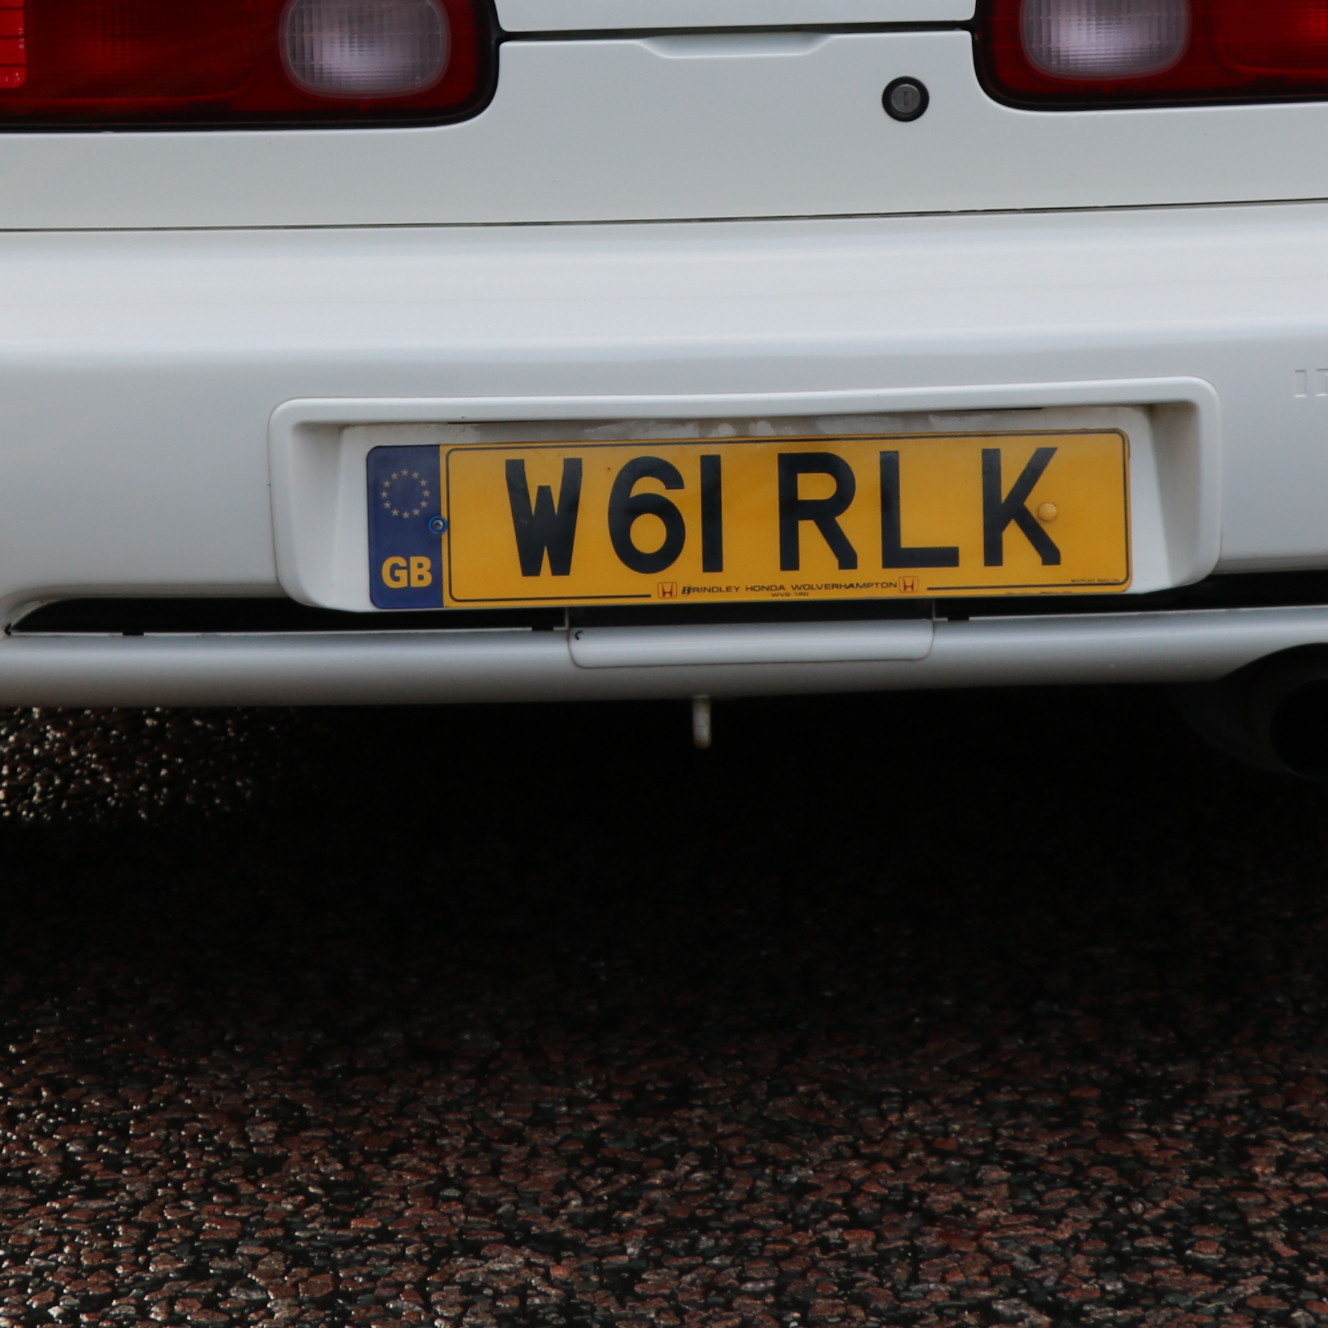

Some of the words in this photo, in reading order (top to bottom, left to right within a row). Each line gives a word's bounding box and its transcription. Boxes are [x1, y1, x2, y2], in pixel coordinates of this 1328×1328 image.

[504, 454, 723, 576] W61
[777, 446, 1062, 572] RLK
[381, 556, 433, 589] GB
[745, 584, 786, 592] HONDA
[791, 582, 898, 591] WOLVERHAMPTON
